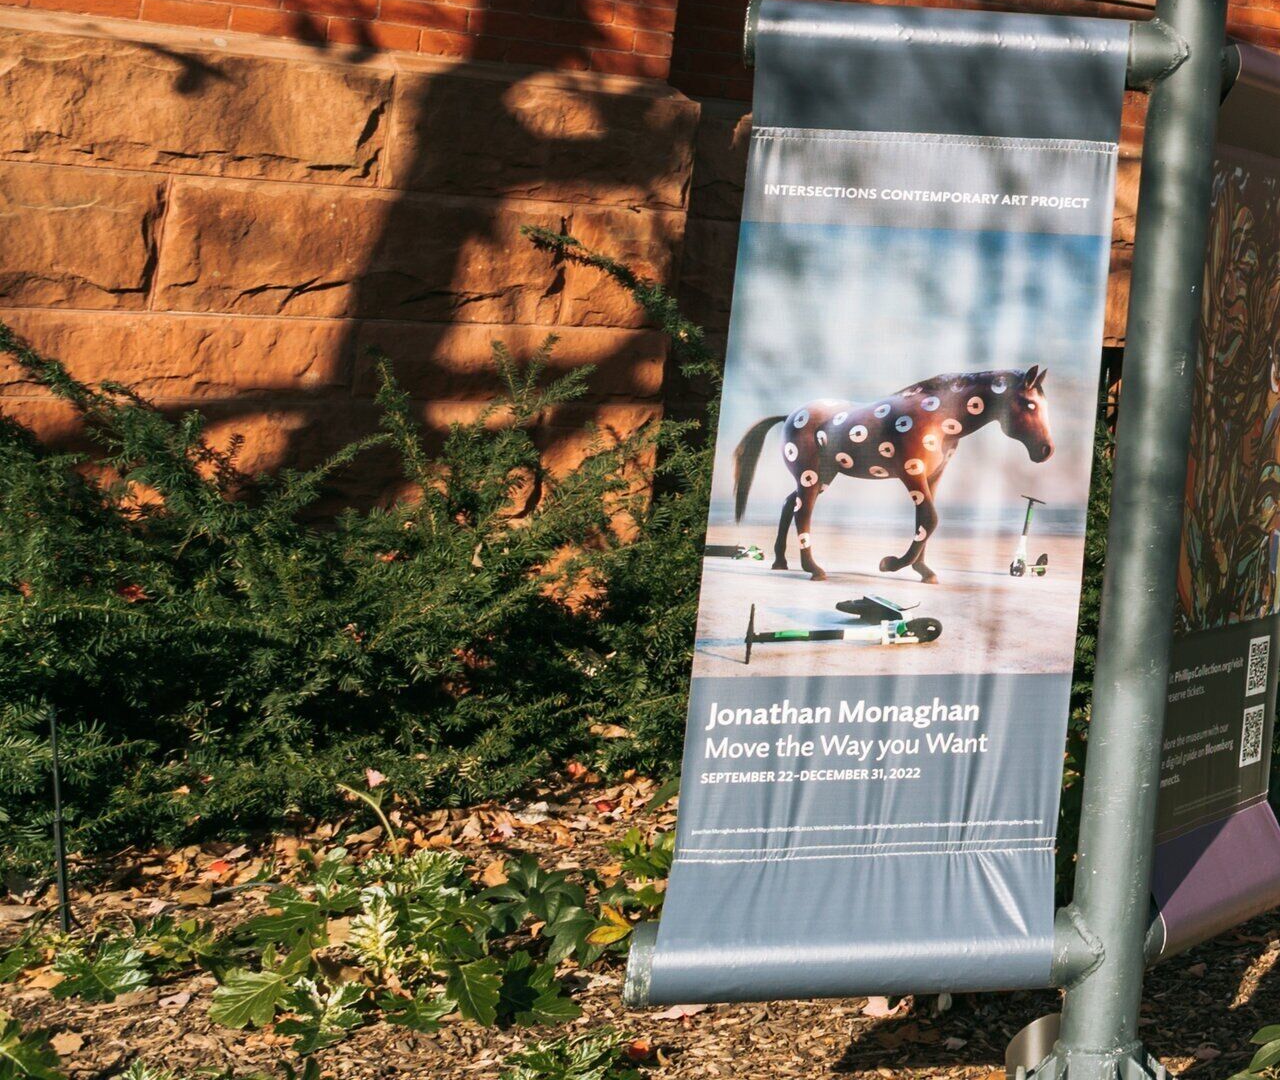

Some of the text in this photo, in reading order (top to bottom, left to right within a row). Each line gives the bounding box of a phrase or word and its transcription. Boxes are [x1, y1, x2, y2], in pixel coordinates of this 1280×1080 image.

[764, 183, 1091, 209] INTERSECTIONS CONTEMPORARY ART PROJECT
[705, 697, 980, 731] Jonathan Monaghan
[704, 732, 989, 761] Move the Way you Want
[700, 769, 776, 784] SEPTEMBER
[871, 768, 889, 781] 31,
[889, 767, 921, 780] 2022
